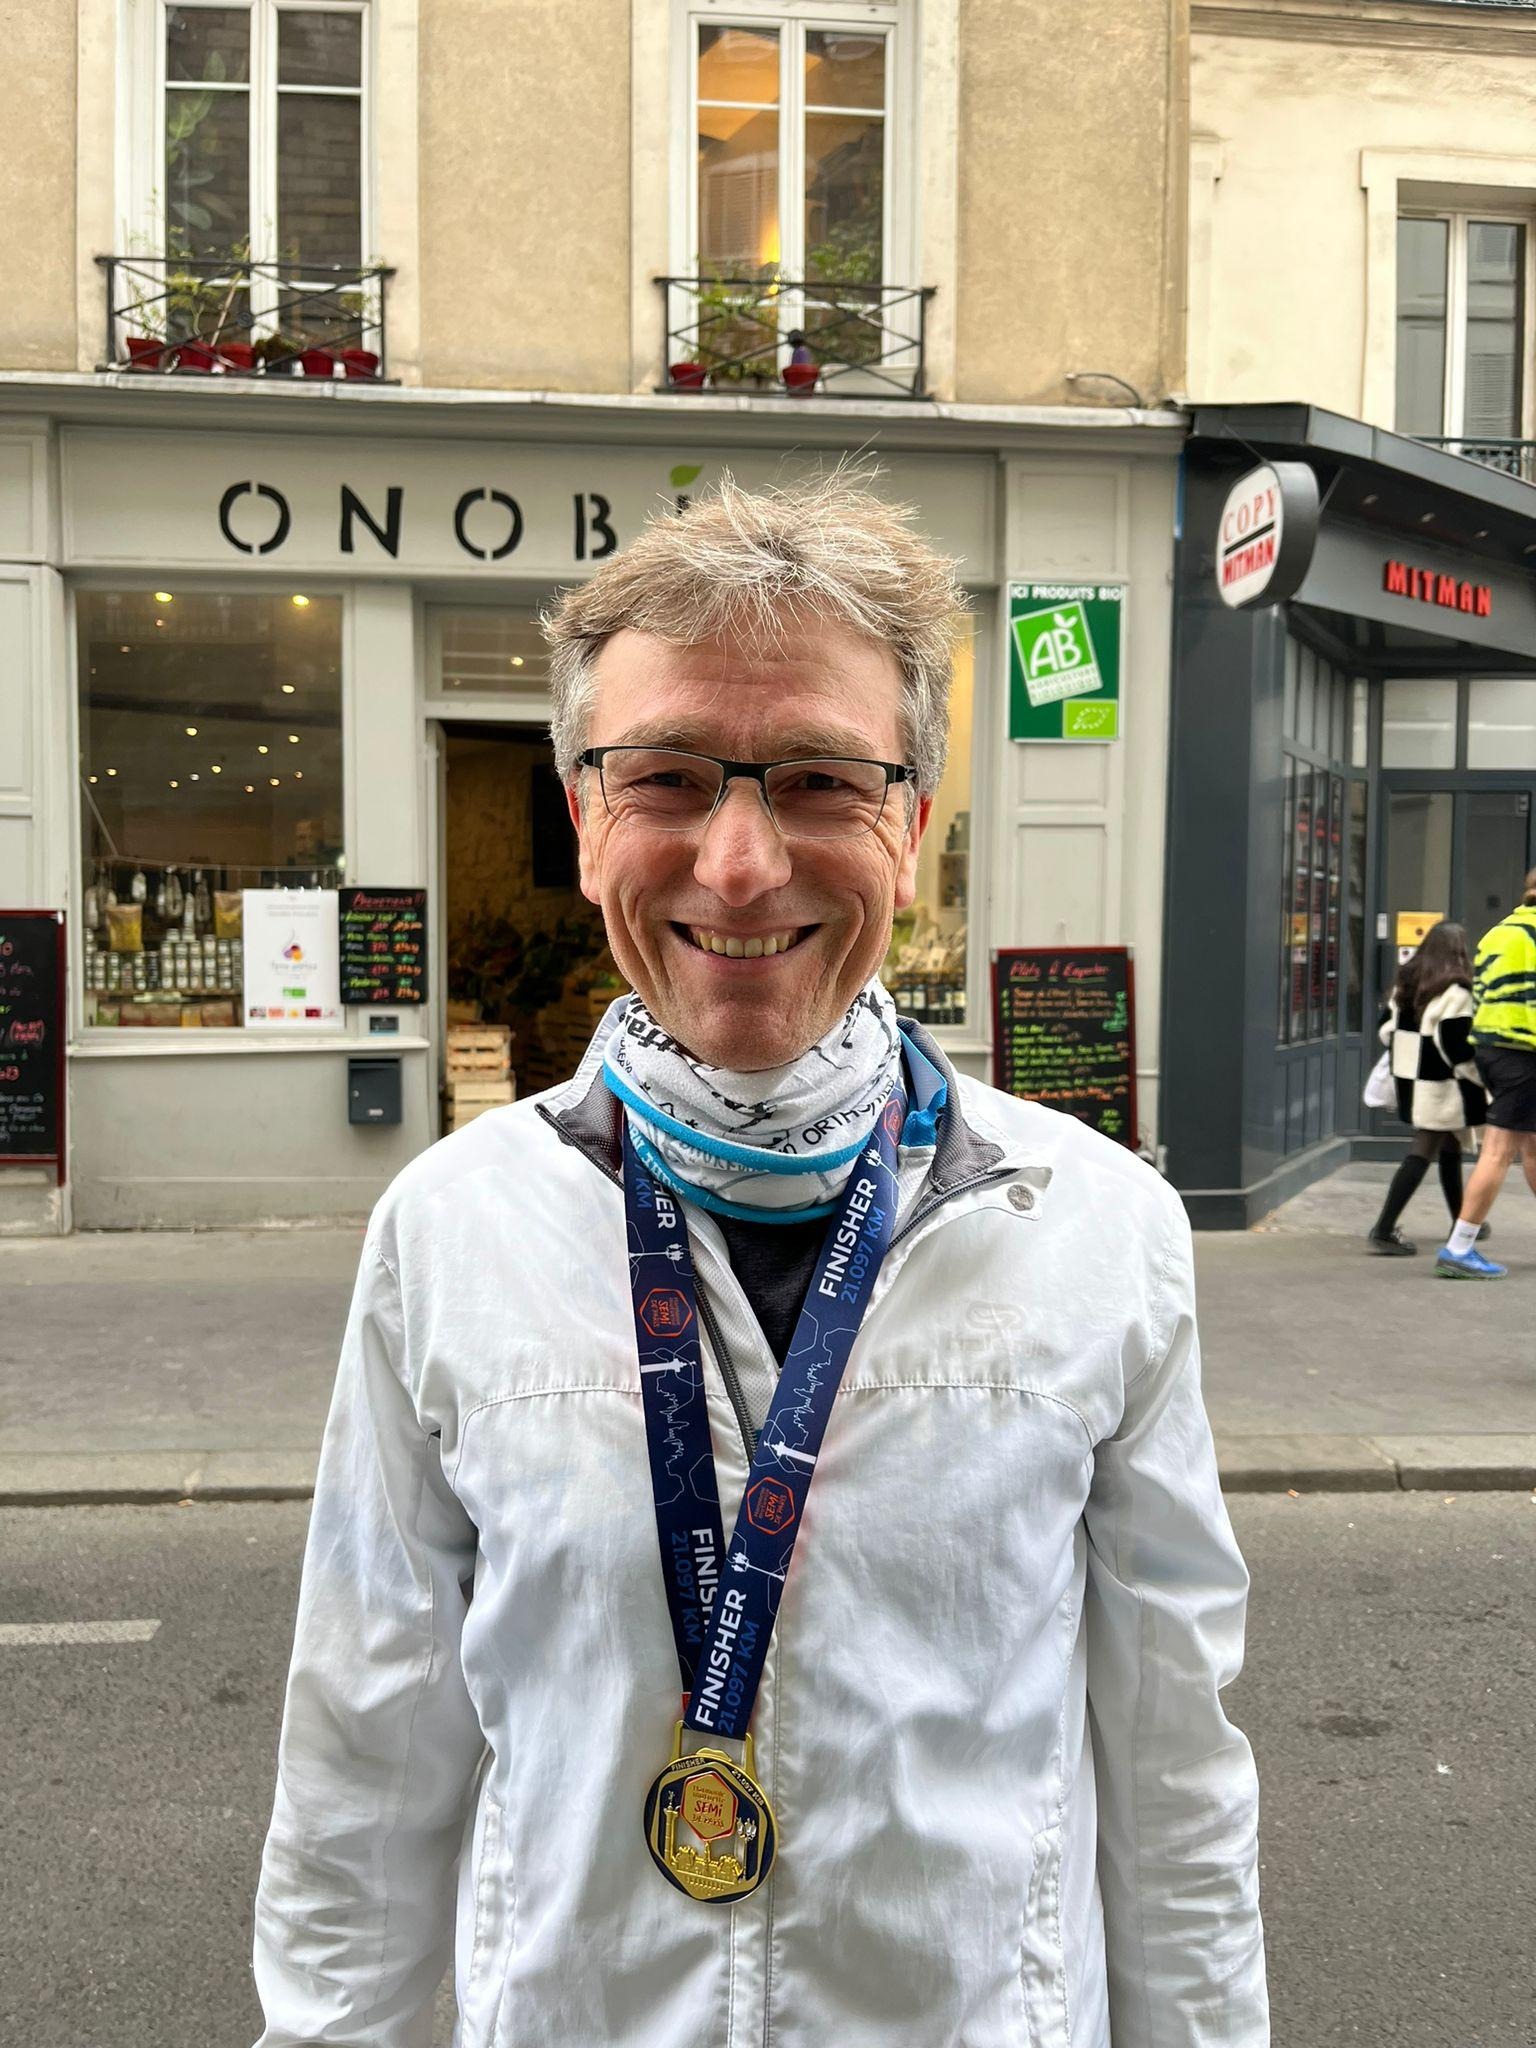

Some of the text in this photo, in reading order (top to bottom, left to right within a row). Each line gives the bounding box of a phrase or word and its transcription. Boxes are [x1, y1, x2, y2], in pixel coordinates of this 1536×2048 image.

[219, 481, 690, 561] ONOB
[1222, 487, 1275, 543] COPY
[1223, 534, 1275, 587] MITMAN
[1384, 560, 1492, 616] MITMAN
[1012, 586, 1121, 601] ICI PRODUITS BIO
[1030, 627, 1082, 678] AB
[818, 1178, 877, 1298] FINISHER
[840, 1206, 886, 1304] 21.097 KM
[695, 1588, 747, 1727] FINISHER
[718, 1620, 760, 1735] 21.097 KM
[671, 1758, 706, 1771] FINISHER
